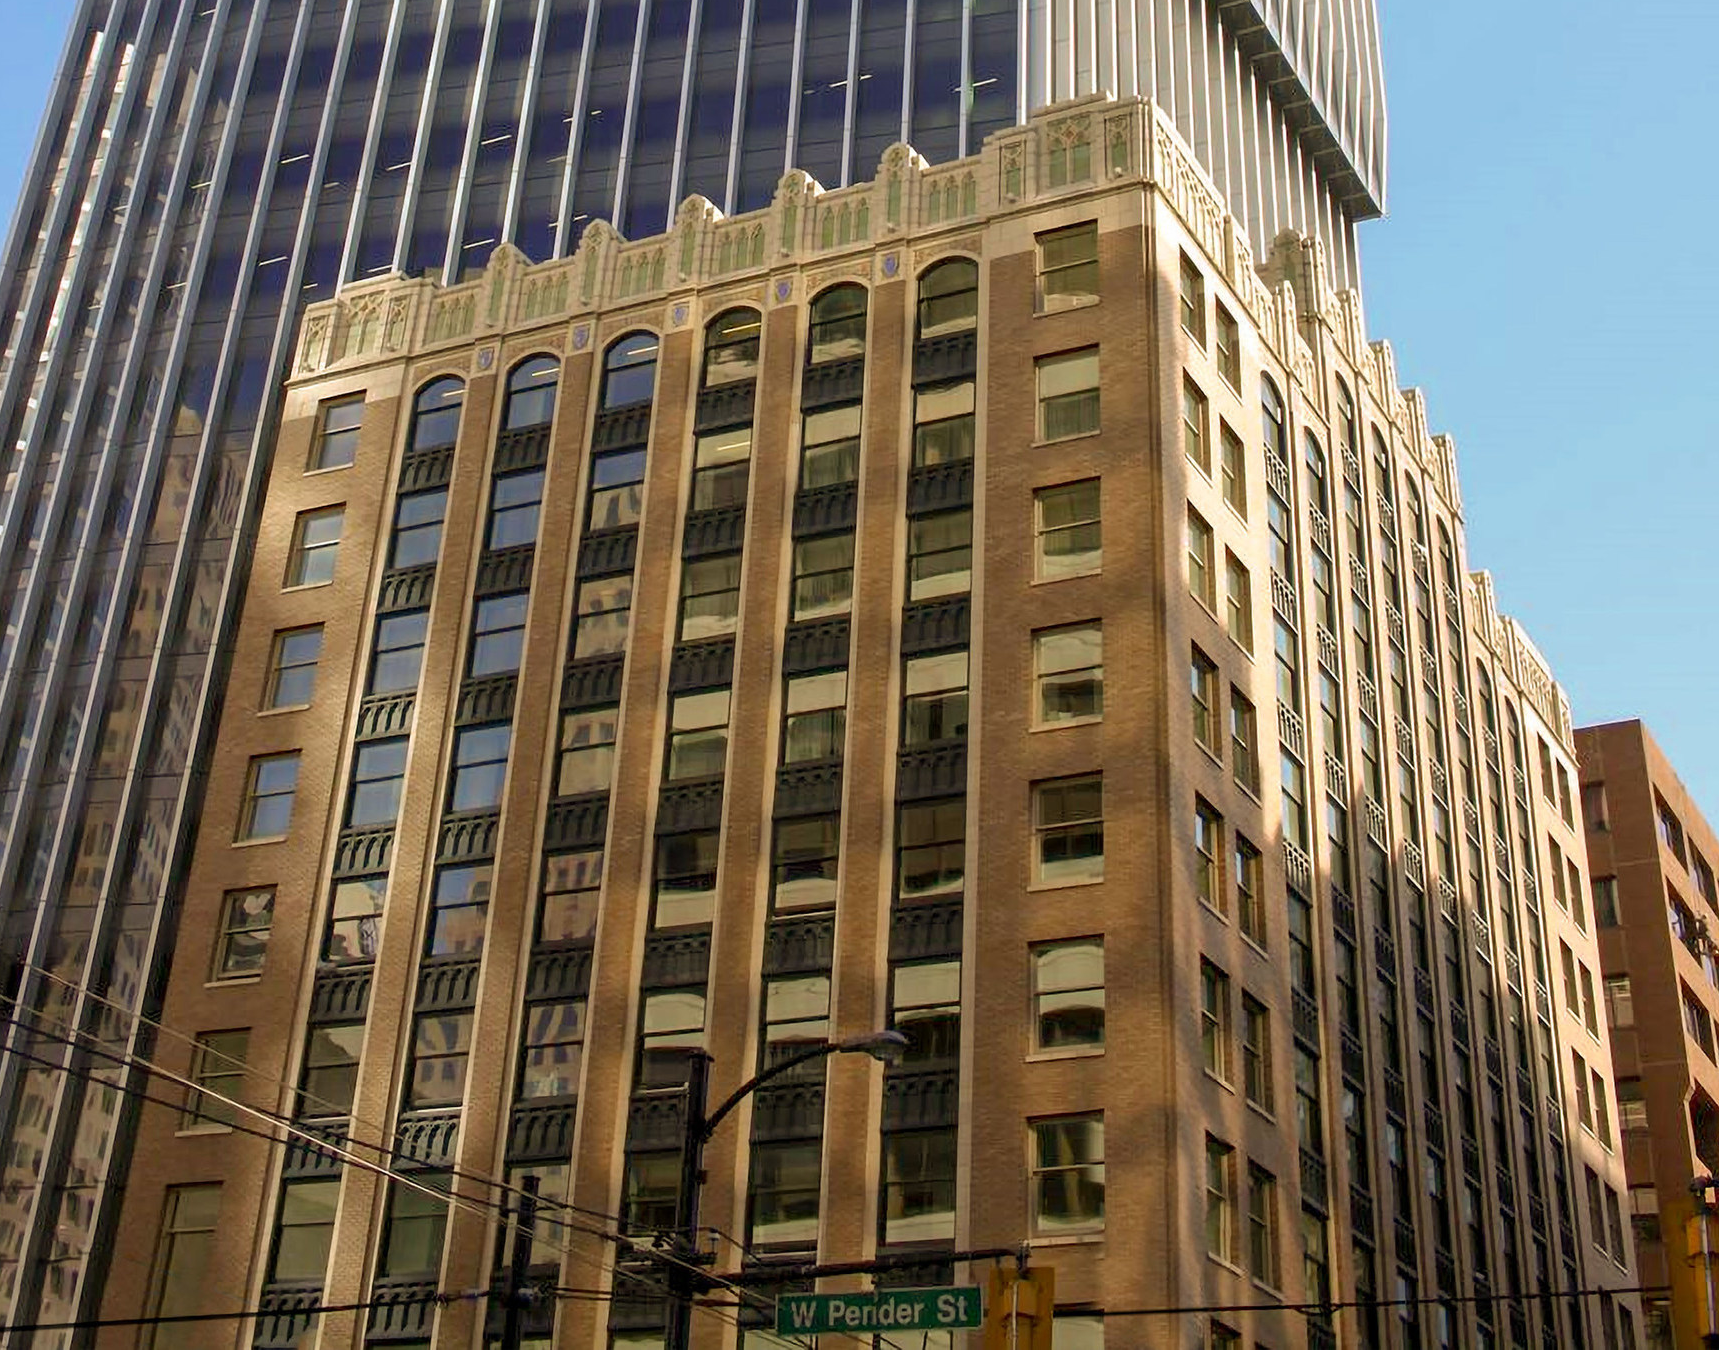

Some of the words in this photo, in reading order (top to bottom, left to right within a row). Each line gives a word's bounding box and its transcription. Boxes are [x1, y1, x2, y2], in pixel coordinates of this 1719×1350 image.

[791, 1302, 817, 1328] W
[829, 1299, 924, 1326] Pender
[937, 1294, 968, 1323] St
